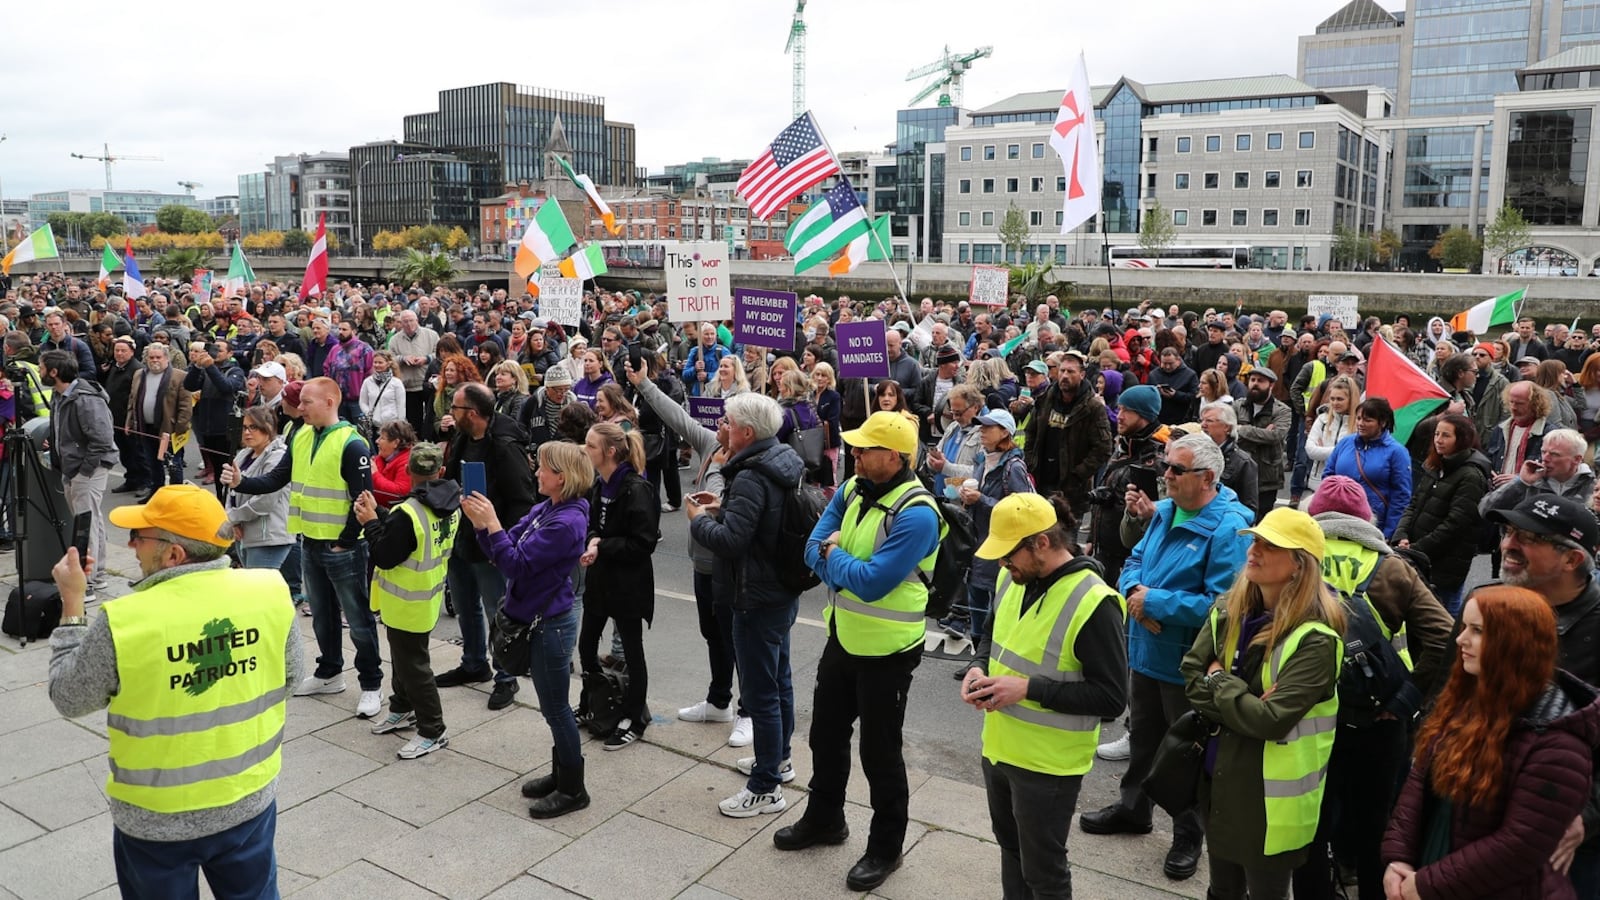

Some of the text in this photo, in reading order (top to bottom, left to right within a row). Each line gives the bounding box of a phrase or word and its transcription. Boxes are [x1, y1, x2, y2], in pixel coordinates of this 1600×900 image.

[667, 253, 721, 269] This war
[685, 274, 718, 288] is on
[678, 296, 720, 312] TRUTH
[741, 295, 788, 309] REMEMBER
[745, 310, 784, 323] MY BODY
[741, 324, 786, 338] MY CHOICE
[849, 336, 873, 348] NO TO
[842, 352, 883, 364] MANDATES
[697, 405, 721, 415] VACCINE
[1321, 555, 1363, 580] ITY
[166, 628, 260, 663] UNITED
[170, 656, 257, 690] PATRIOTS
